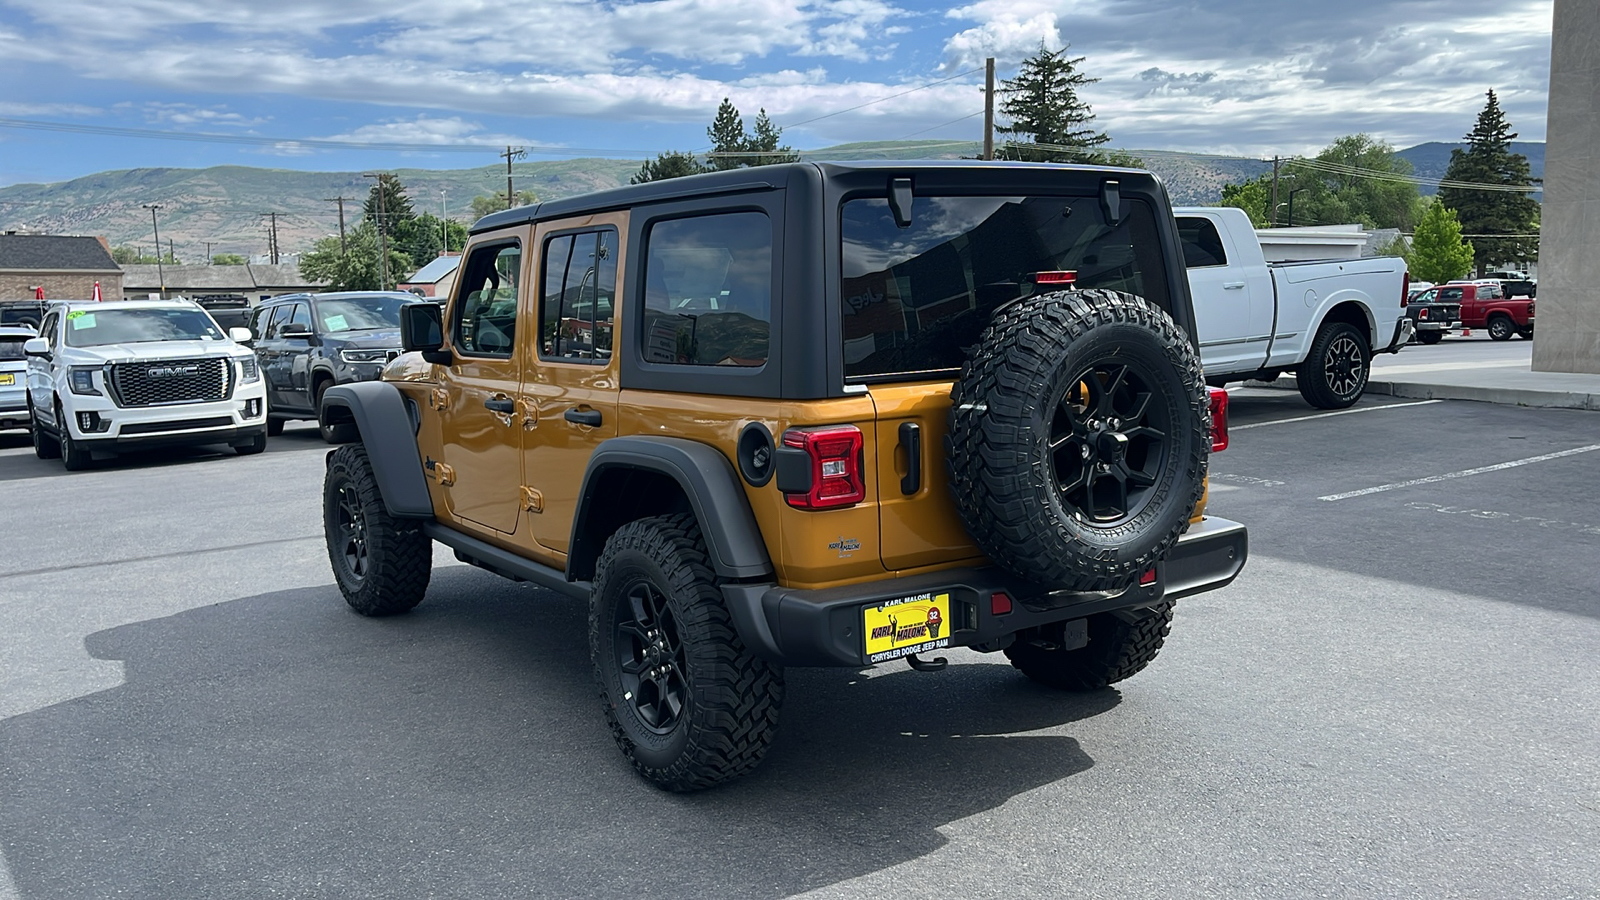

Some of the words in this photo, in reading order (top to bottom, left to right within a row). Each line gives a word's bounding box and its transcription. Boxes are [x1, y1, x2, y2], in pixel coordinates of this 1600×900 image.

[148, 366, 198, 378] GMC
[904, 593, 931, 604] MALONE
[929, 611, 938, 620] 32
[871, 625, 891, 640] KARL
[896, 626, 926, 642] MALONE
[870, 650, 901, 663] CHRYSLER
[901, 645, 921, 657] DODGE
[922, 642, 935, 652] JEEP
[936, 639, 948, 648] RAM
